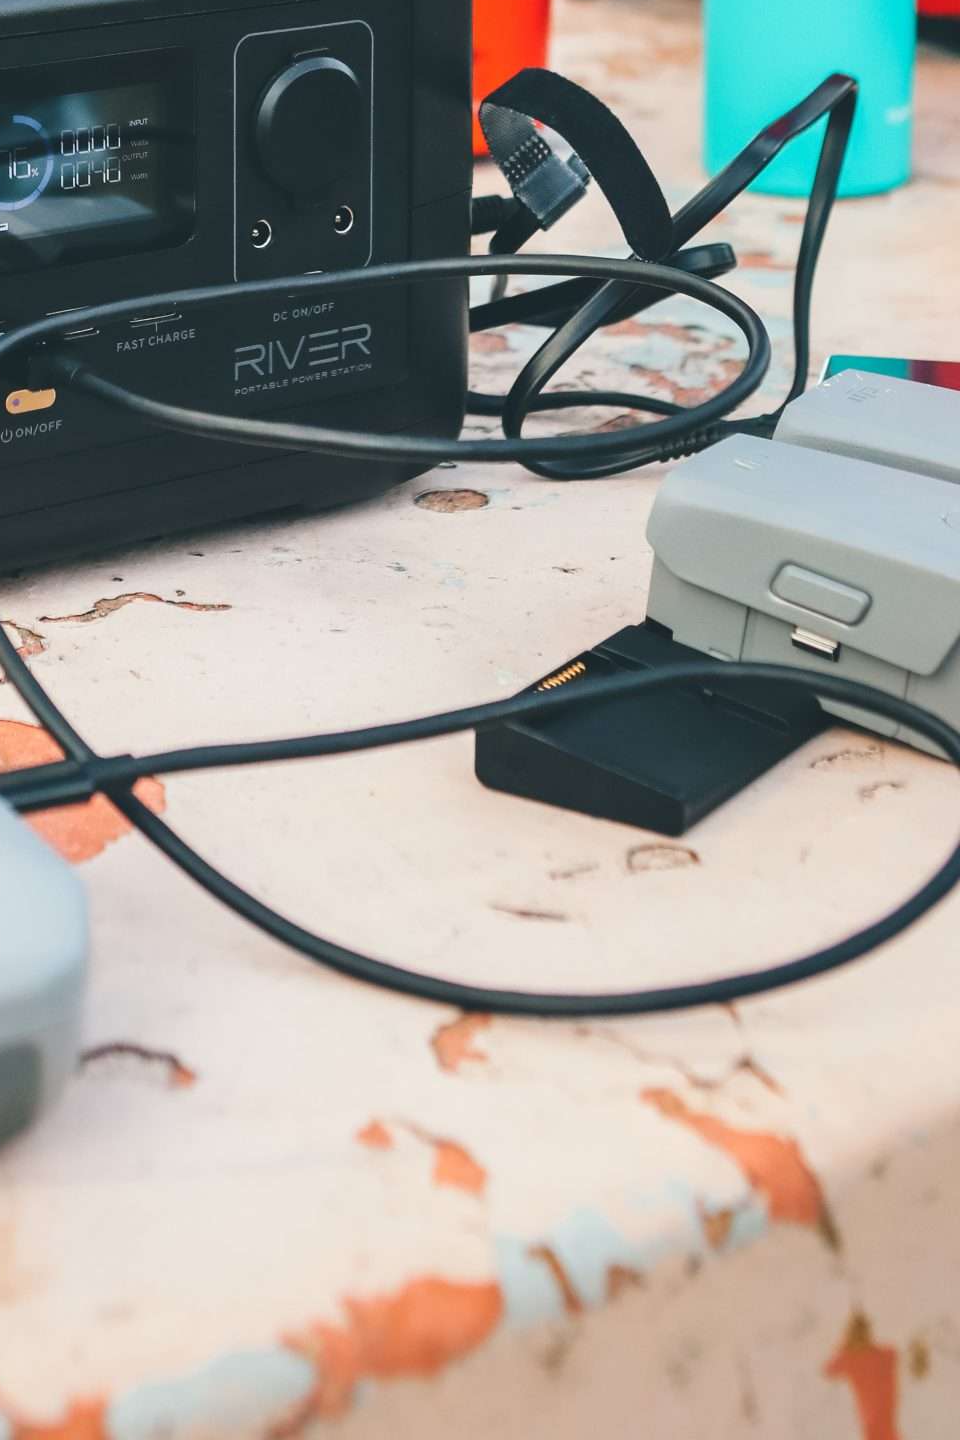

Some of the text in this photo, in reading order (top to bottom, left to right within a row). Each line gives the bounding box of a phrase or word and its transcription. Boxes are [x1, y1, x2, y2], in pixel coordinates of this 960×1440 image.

[128, 117, 149, 128] INPUT
[60, 122, 121, 157] 0000
[122, 151, 149, 162] OUTPUT
[272, 302, 336, 323] DC ON/OFF
[116, 328, 197, 353] FAST CHARGE
[234, 323, 372, 382] RIVER
[234, 362, 373, 397] PORTABLE POWER STATION
[15, 419, 63, 439] ON/OFF
